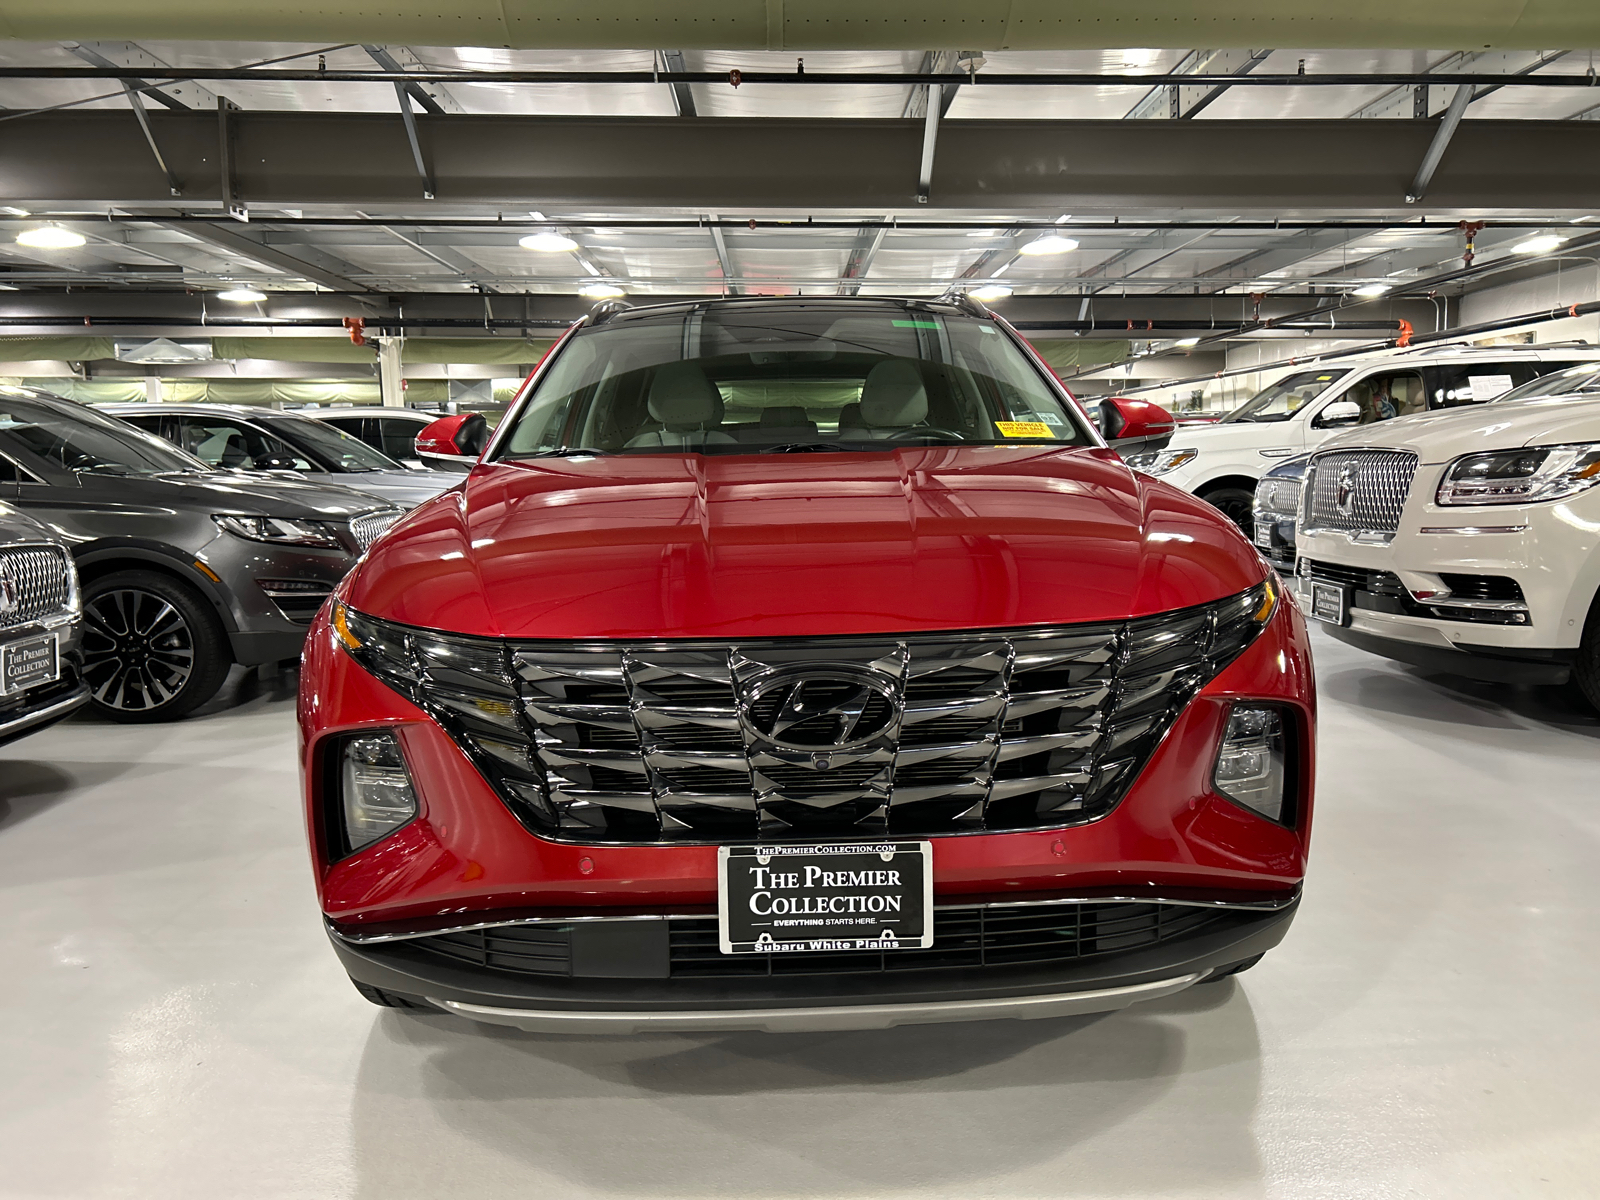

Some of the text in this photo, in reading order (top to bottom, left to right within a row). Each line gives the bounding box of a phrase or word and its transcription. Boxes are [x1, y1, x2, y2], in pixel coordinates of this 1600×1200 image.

[8, 647, 49, 665] THE PREMIER
[8, 658, 50, 677] COLLECTION
[749, 865, 902, 889] THE PREMIER
[749, 891, 902, 915] COLLECTION
[773, 917, 878, 927] EVERYTHING STARTS HERE.
[754, 939, 900, 952] Subaru White Plains
